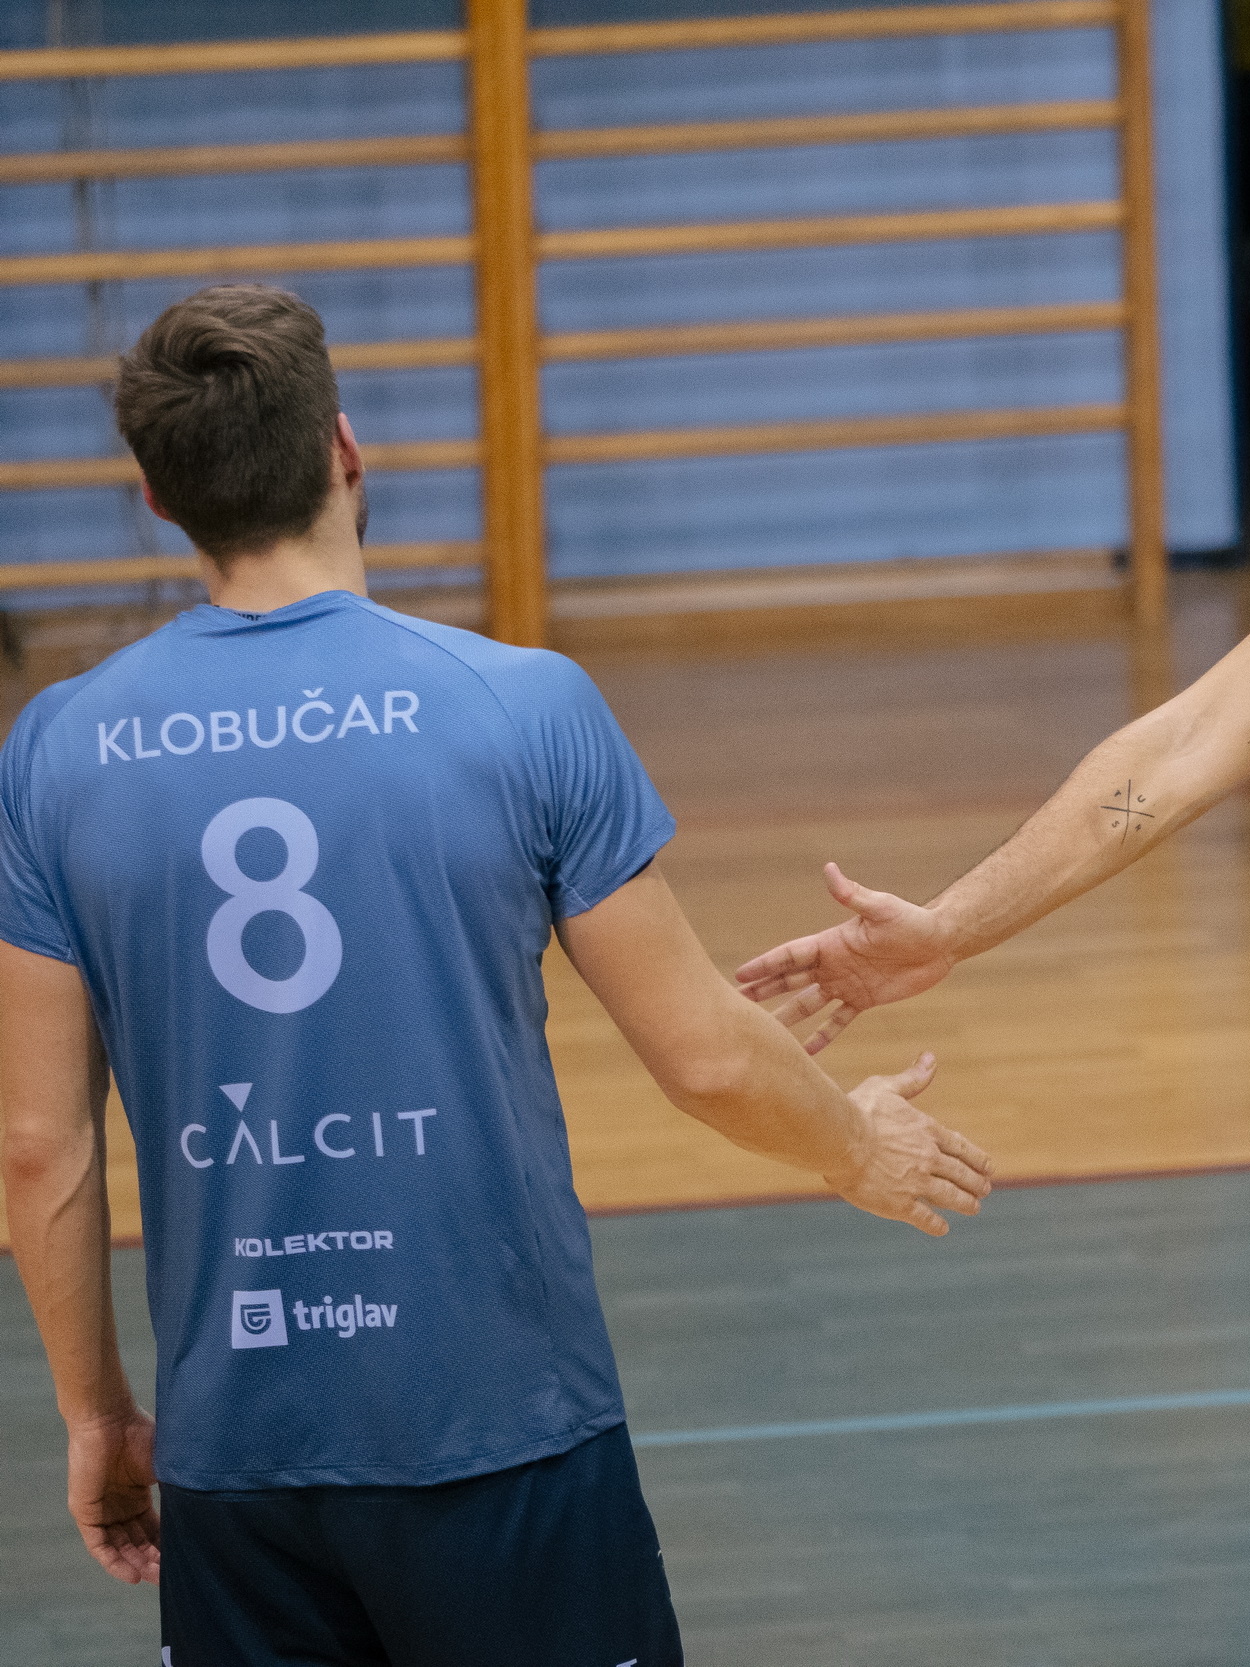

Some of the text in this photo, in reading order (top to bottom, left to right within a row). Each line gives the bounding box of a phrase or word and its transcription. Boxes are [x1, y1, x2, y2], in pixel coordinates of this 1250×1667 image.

[96, 687, 421, 766] KLOBUČAR
[201, 796, 343, 1014] 8
[180, 1107, 437, 1169] CALCIT
[234, 1230, 394, 1258] KOLEKTOR
[292, 1293, 398, 1339] triglav
